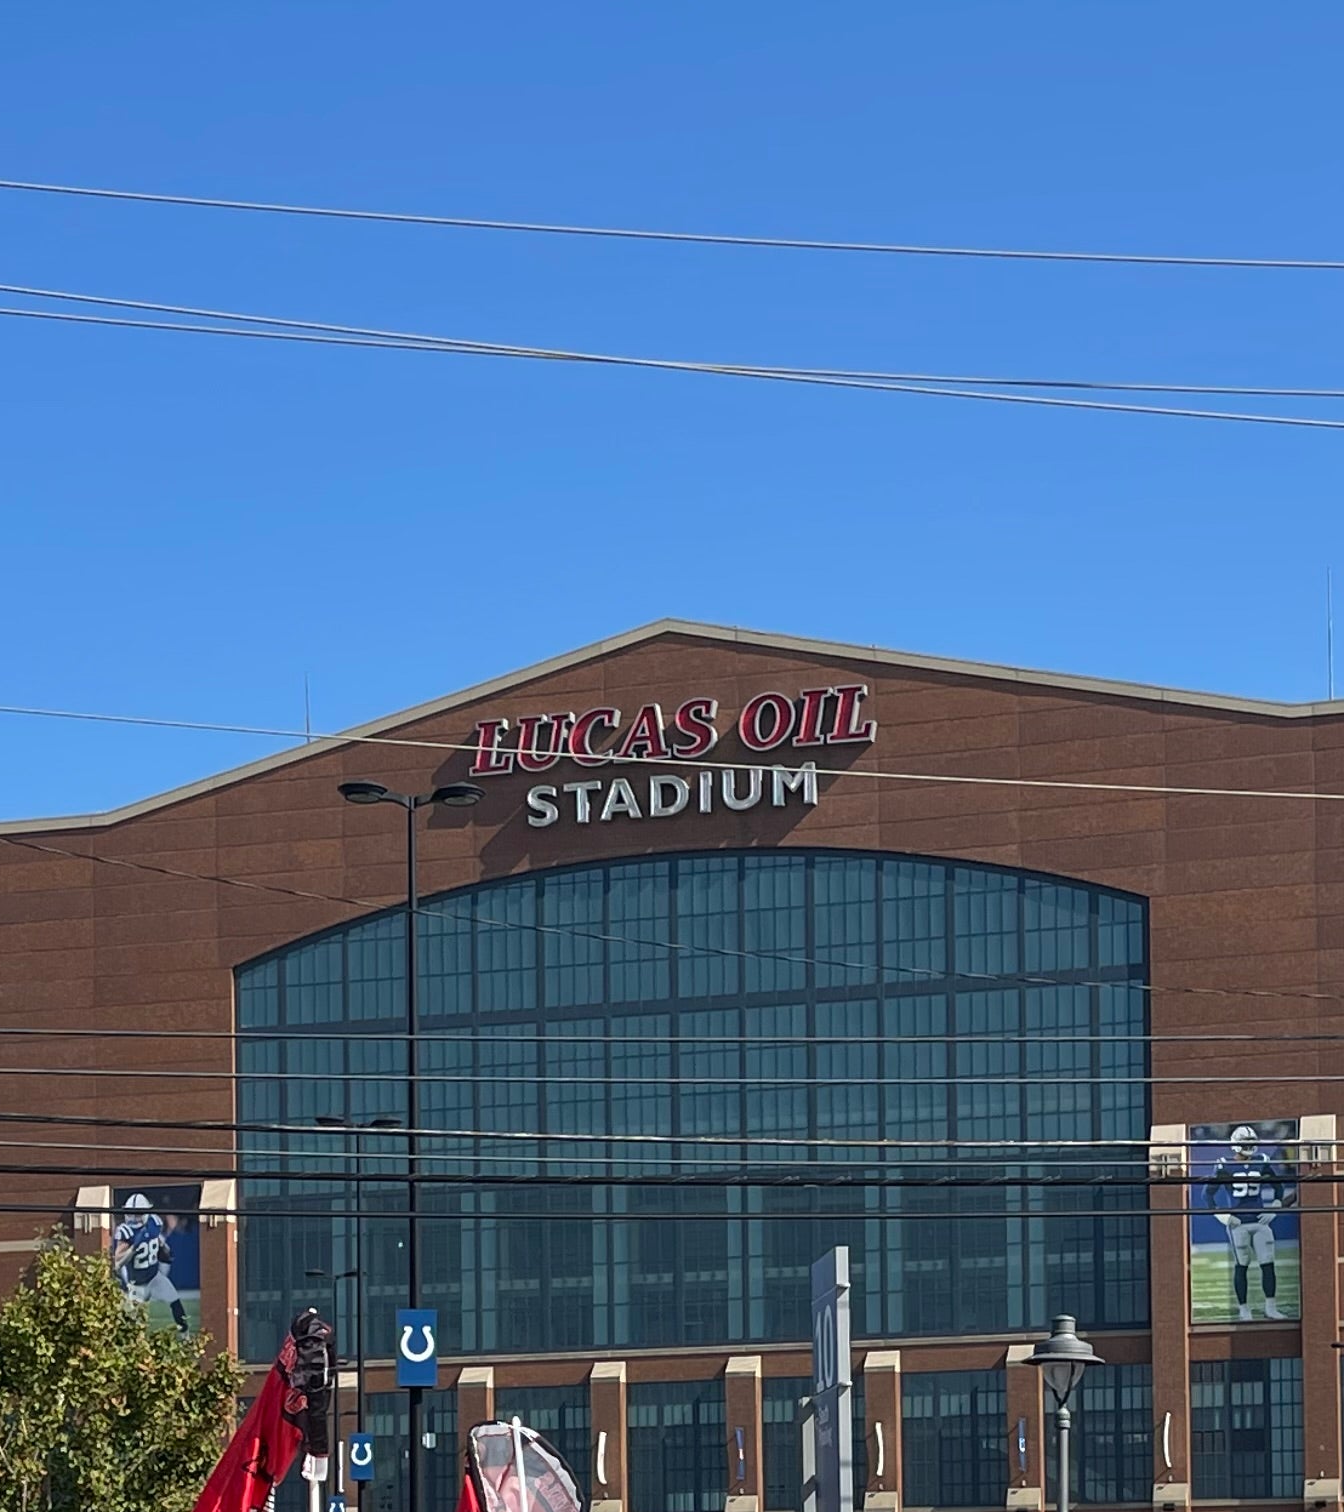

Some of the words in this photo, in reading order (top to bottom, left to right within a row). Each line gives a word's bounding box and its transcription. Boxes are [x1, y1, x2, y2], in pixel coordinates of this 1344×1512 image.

[469, 697, 718, 777] LUCAS
[739, 684, 877, 752] OIL
[525, 761, 819, 828] STADIUM
[134, 1238, 159, 1269] 28
[815, 1305, 834, 1393] 10
